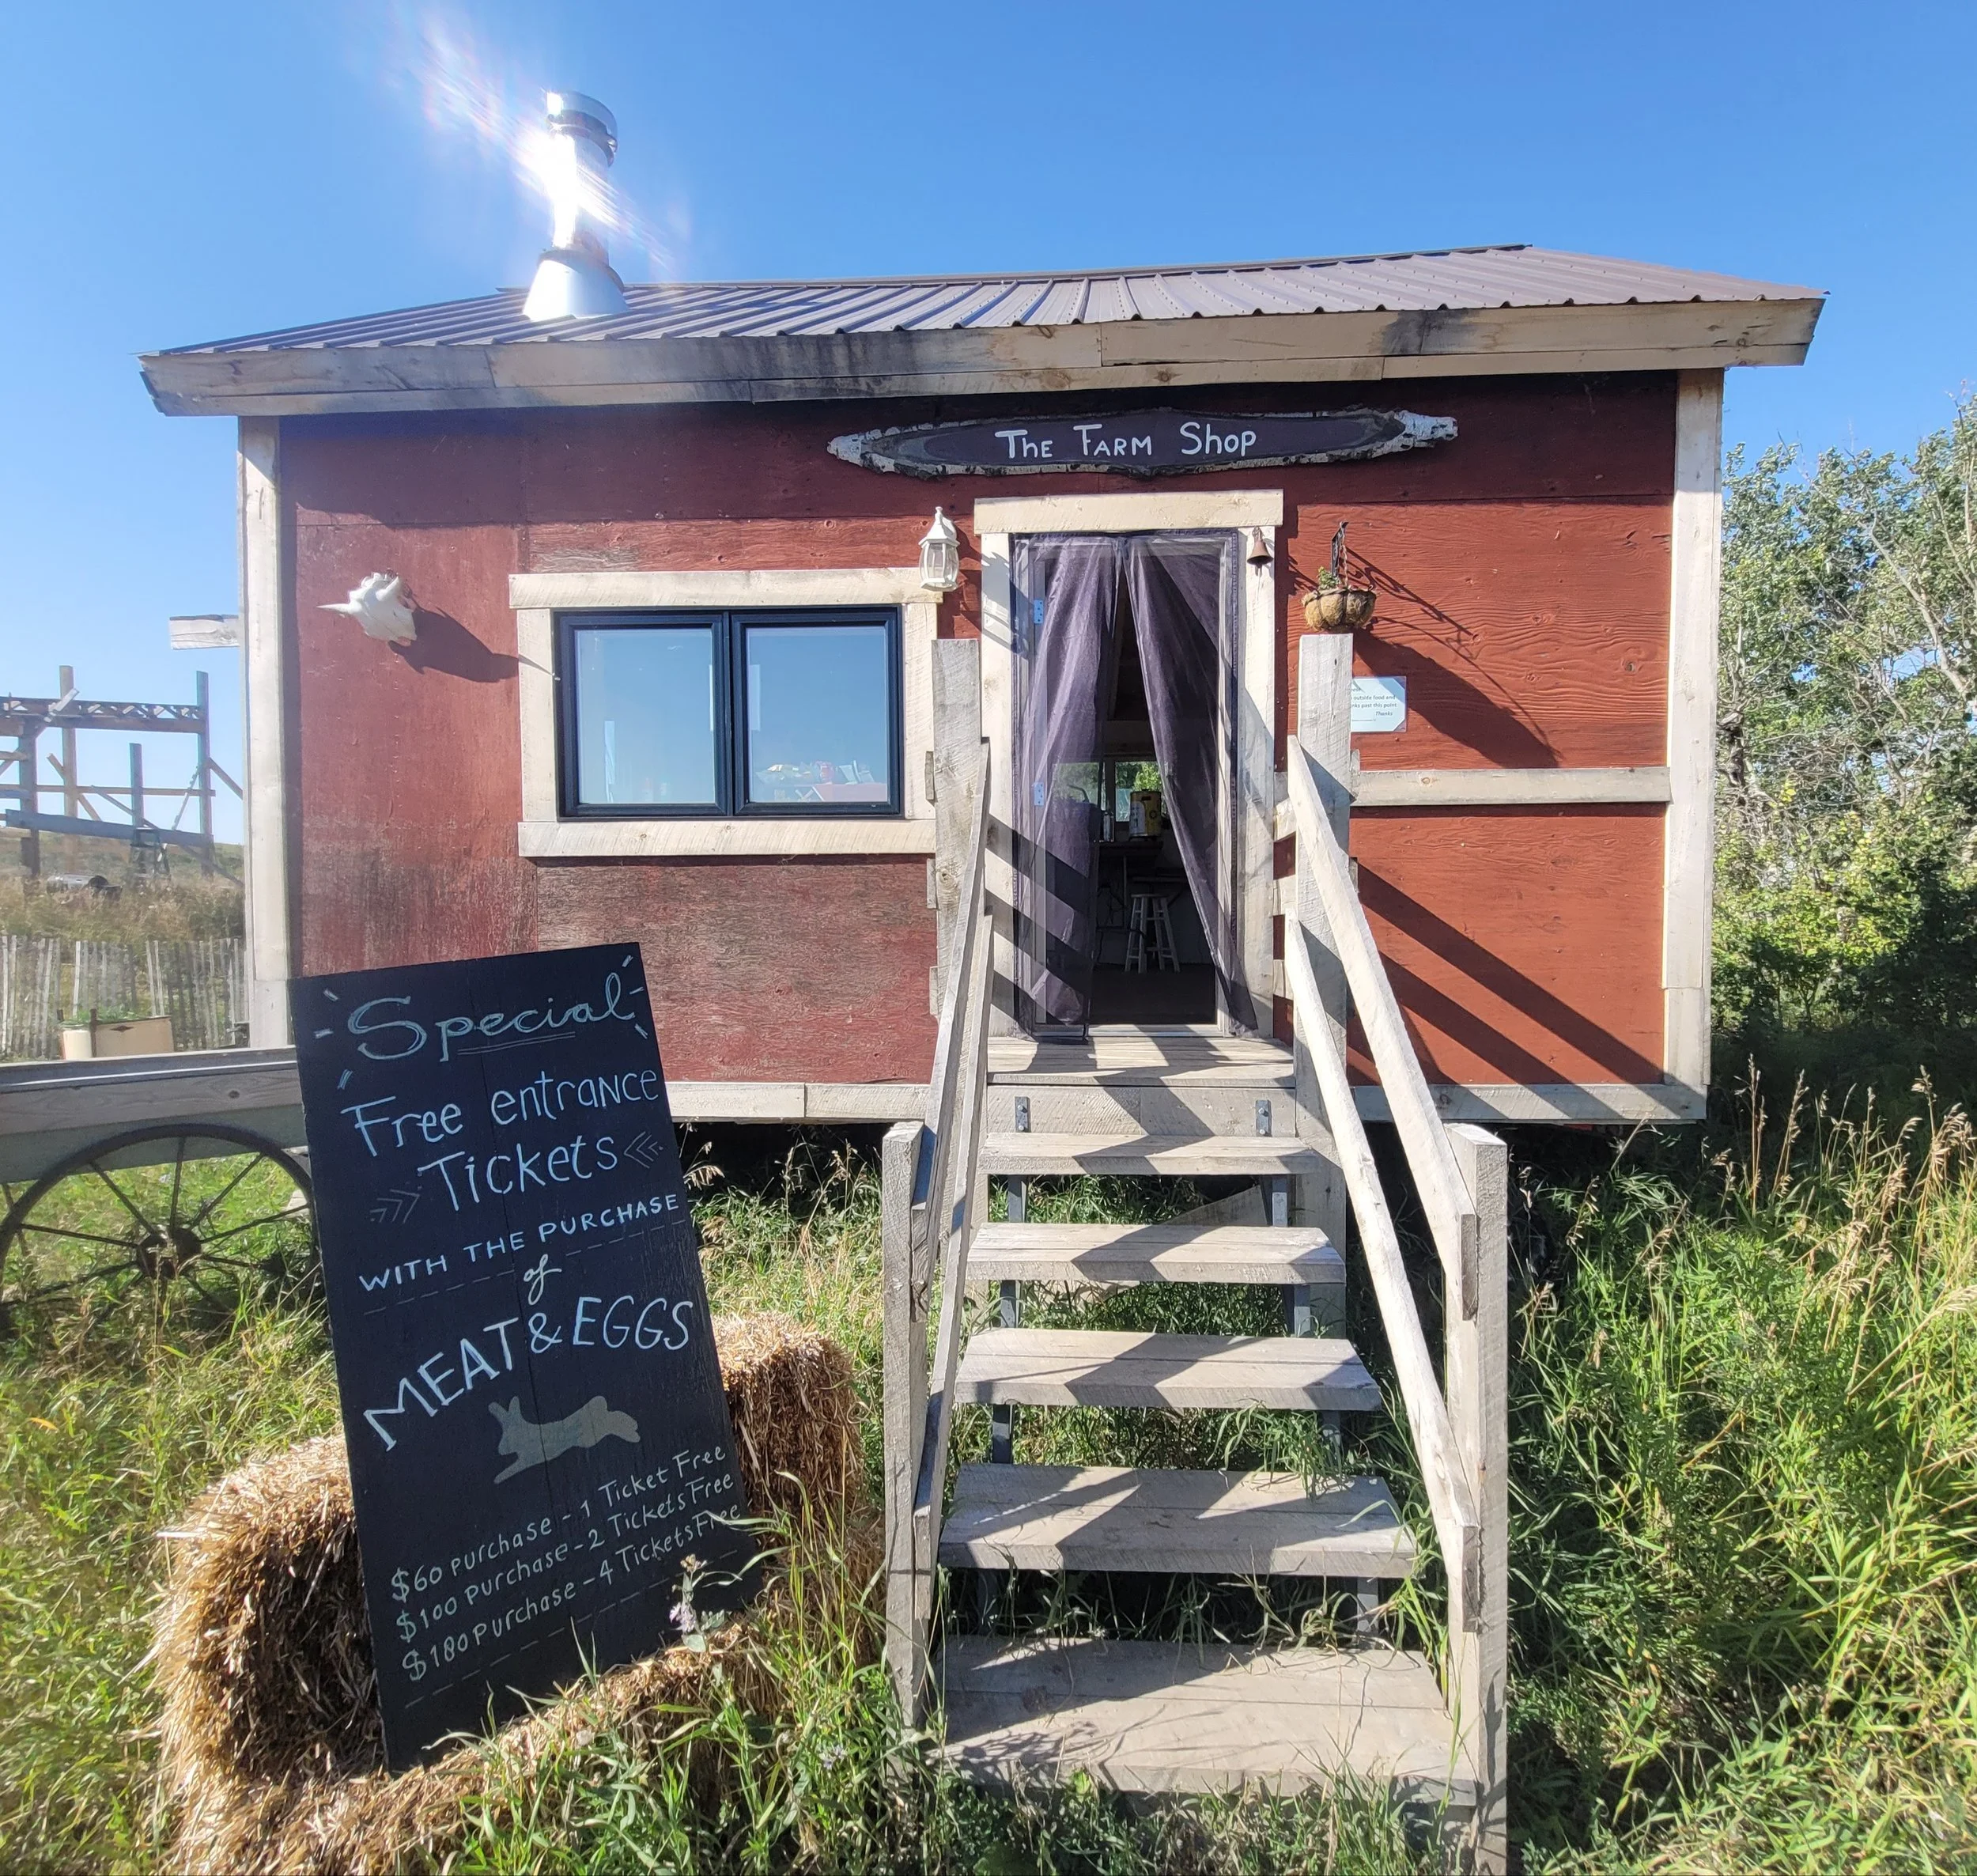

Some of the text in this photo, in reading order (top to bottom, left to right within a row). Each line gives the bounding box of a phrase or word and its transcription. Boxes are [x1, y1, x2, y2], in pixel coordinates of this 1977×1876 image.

[1180, 422, 1257, 456] Shop
[348, 972, 636, 1062] Special
[341, 1095, 464, 1157] Free
[417, 1135, 618, 1212] Tickets
[359, 1193, 679, 1292] WITH THE PURCHASE
[523, 1254, 562, 1305] of
[362, 1295, 694, 1451] MEAT & EGGS
[391, 1564, 443, 1604] $60
[580, 1500, 591, 1518] 1
[597, 1466, 669, 1507] Ticket
[672, 1446, 726, 1478] Free
[395, 1596, 457, 1643] $100
[588, 1529, 606, 1551] 2
[607, 1492, 686, 1537] Tickets
[685, 1473, 734, 1504] Free
[402, 1609, 468, 1681] $180
[599, 1559, 614, 1584] 4
[614, 1523, 693, 1573] Tickets
